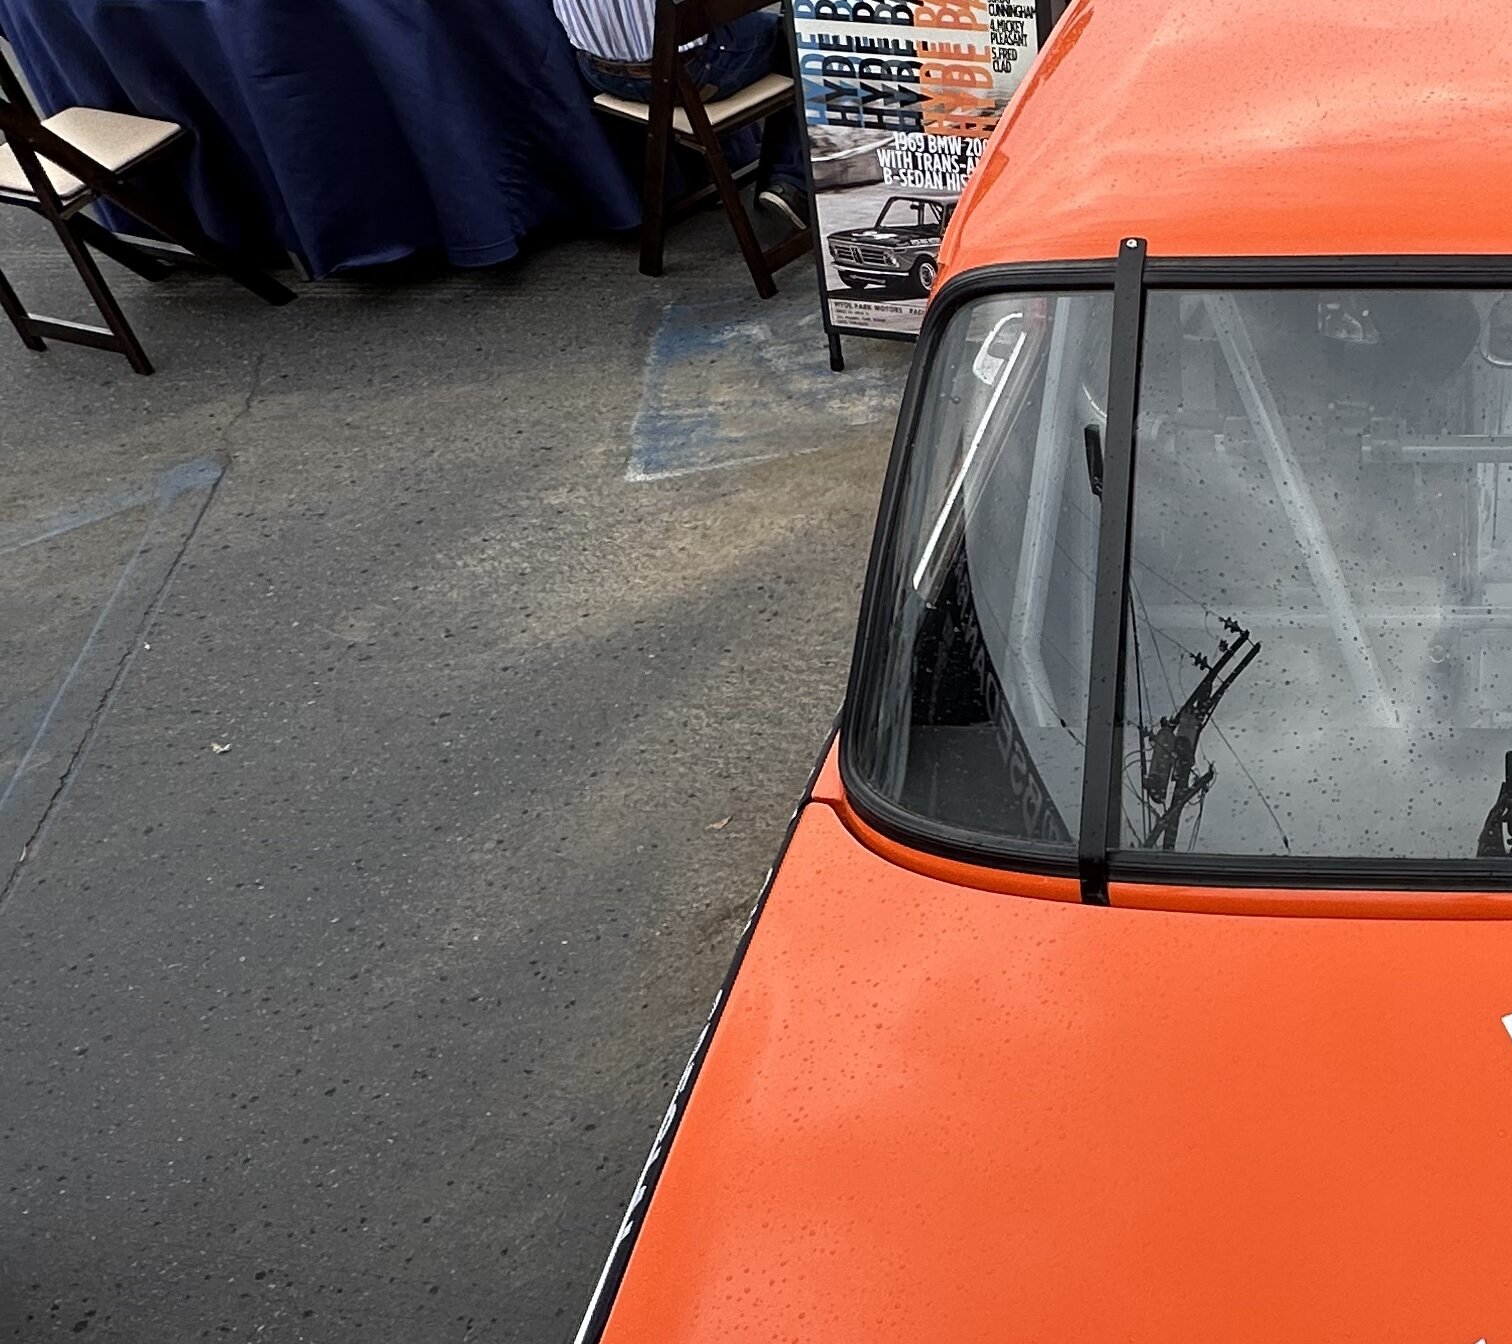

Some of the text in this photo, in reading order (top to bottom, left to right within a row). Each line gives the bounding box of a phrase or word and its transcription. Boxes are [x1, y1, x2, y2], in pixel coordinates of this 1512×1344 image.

[892, 132, 925, 152] 1969
[927, 135, 962, 156] BMW
[877, 149, 981, 175] WITH TRANS-A
[883, 167, 969, 193] B-SEDAN HIS
[874, 305, 903, 314] MOTORS
